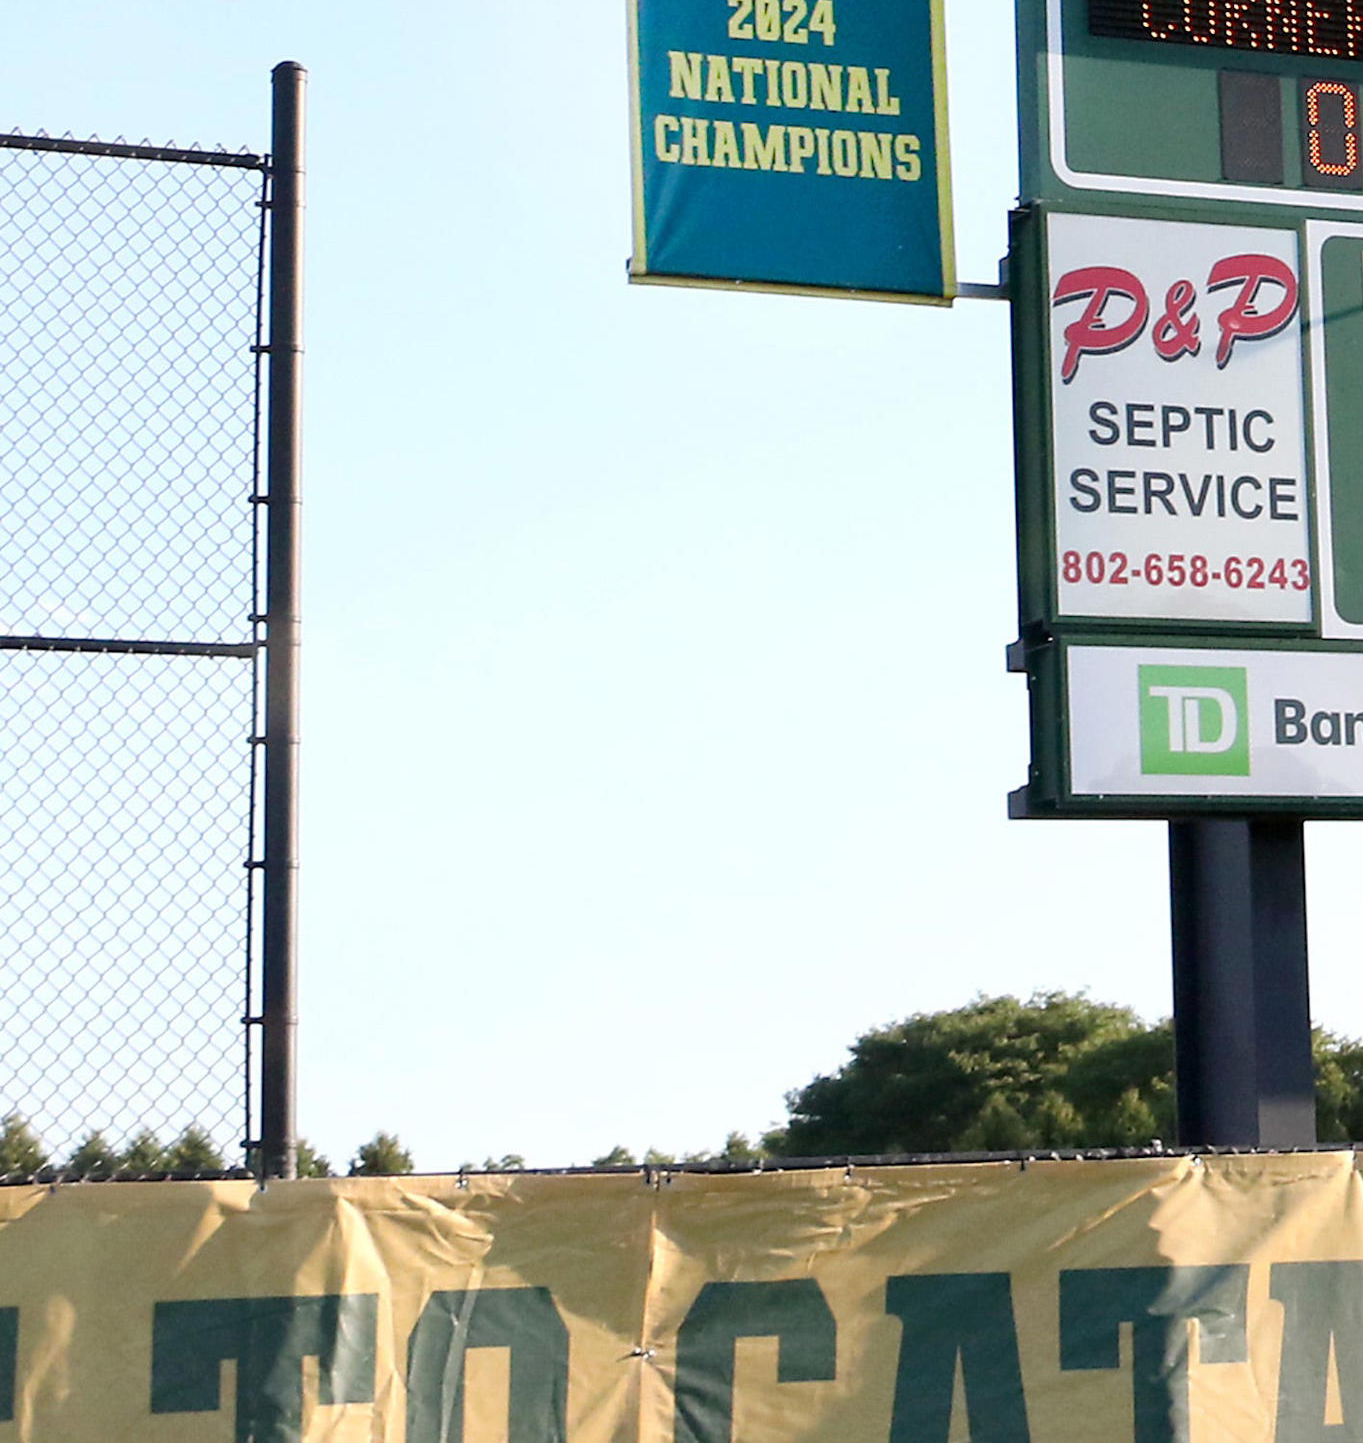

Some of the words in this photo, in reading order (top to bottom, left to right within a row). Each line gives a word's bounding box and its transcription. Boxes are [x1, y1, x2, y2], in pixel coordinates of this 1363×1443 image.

[668, 50, 901, 117] NATIONAL
[653, 114, 923, 182] CHAMPIONS
[1306, 82, 1356, 176] 0
[1053, 253, 1300, 385] P&P
[1088, 400, 1276, 454] SEPTIC
[1069, 468, 1300, 522] SERVICE
[1062, 550, 1311, 591] 802-658-6243
[1149, 685, 1238, 754] TD
